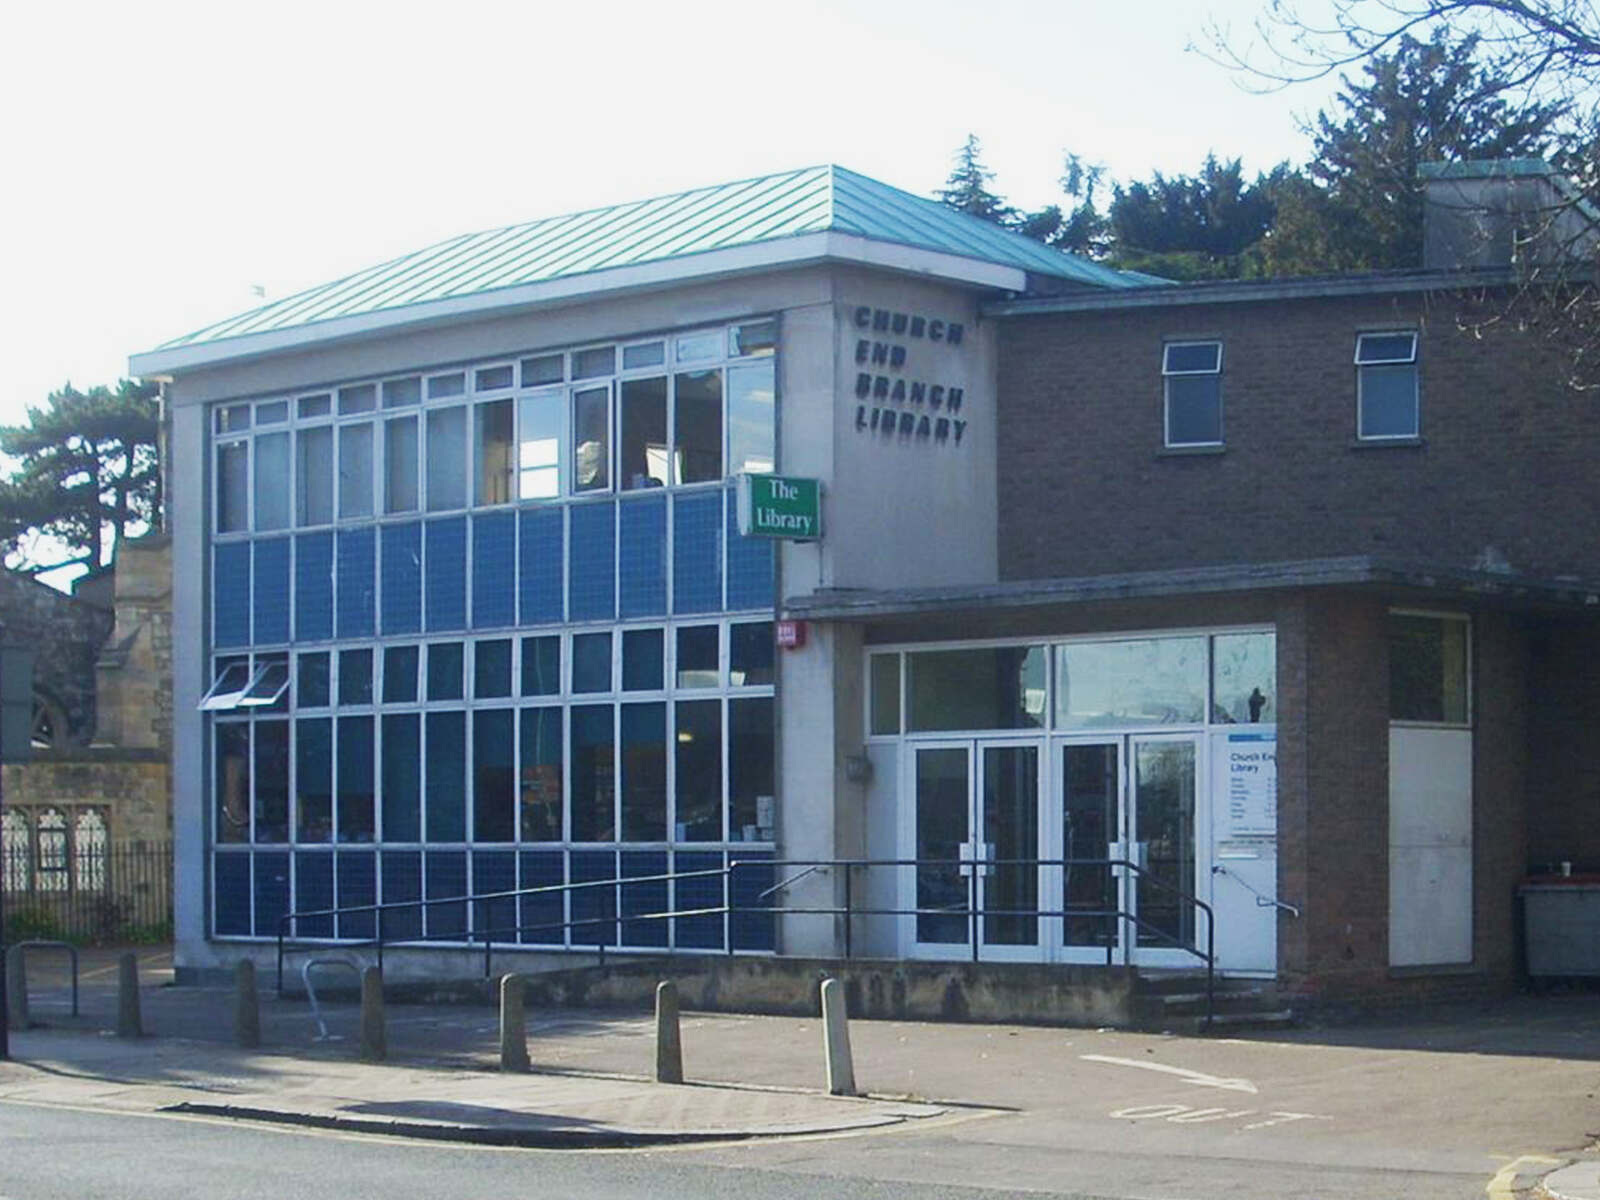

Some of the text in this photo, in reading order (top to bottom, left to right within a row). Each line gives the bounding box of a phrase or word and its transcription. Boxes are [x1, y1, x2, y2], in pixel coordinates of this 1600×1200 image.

[854, 306, 964, 344] CHURCH
[855, 339, 907, 368] END
[855, 372, 964, 413] BRANCH
[855, 405, 967, 445] LIBRARY
[769, 479, 799, 500] The
[757, 507, 812, 535] Library
